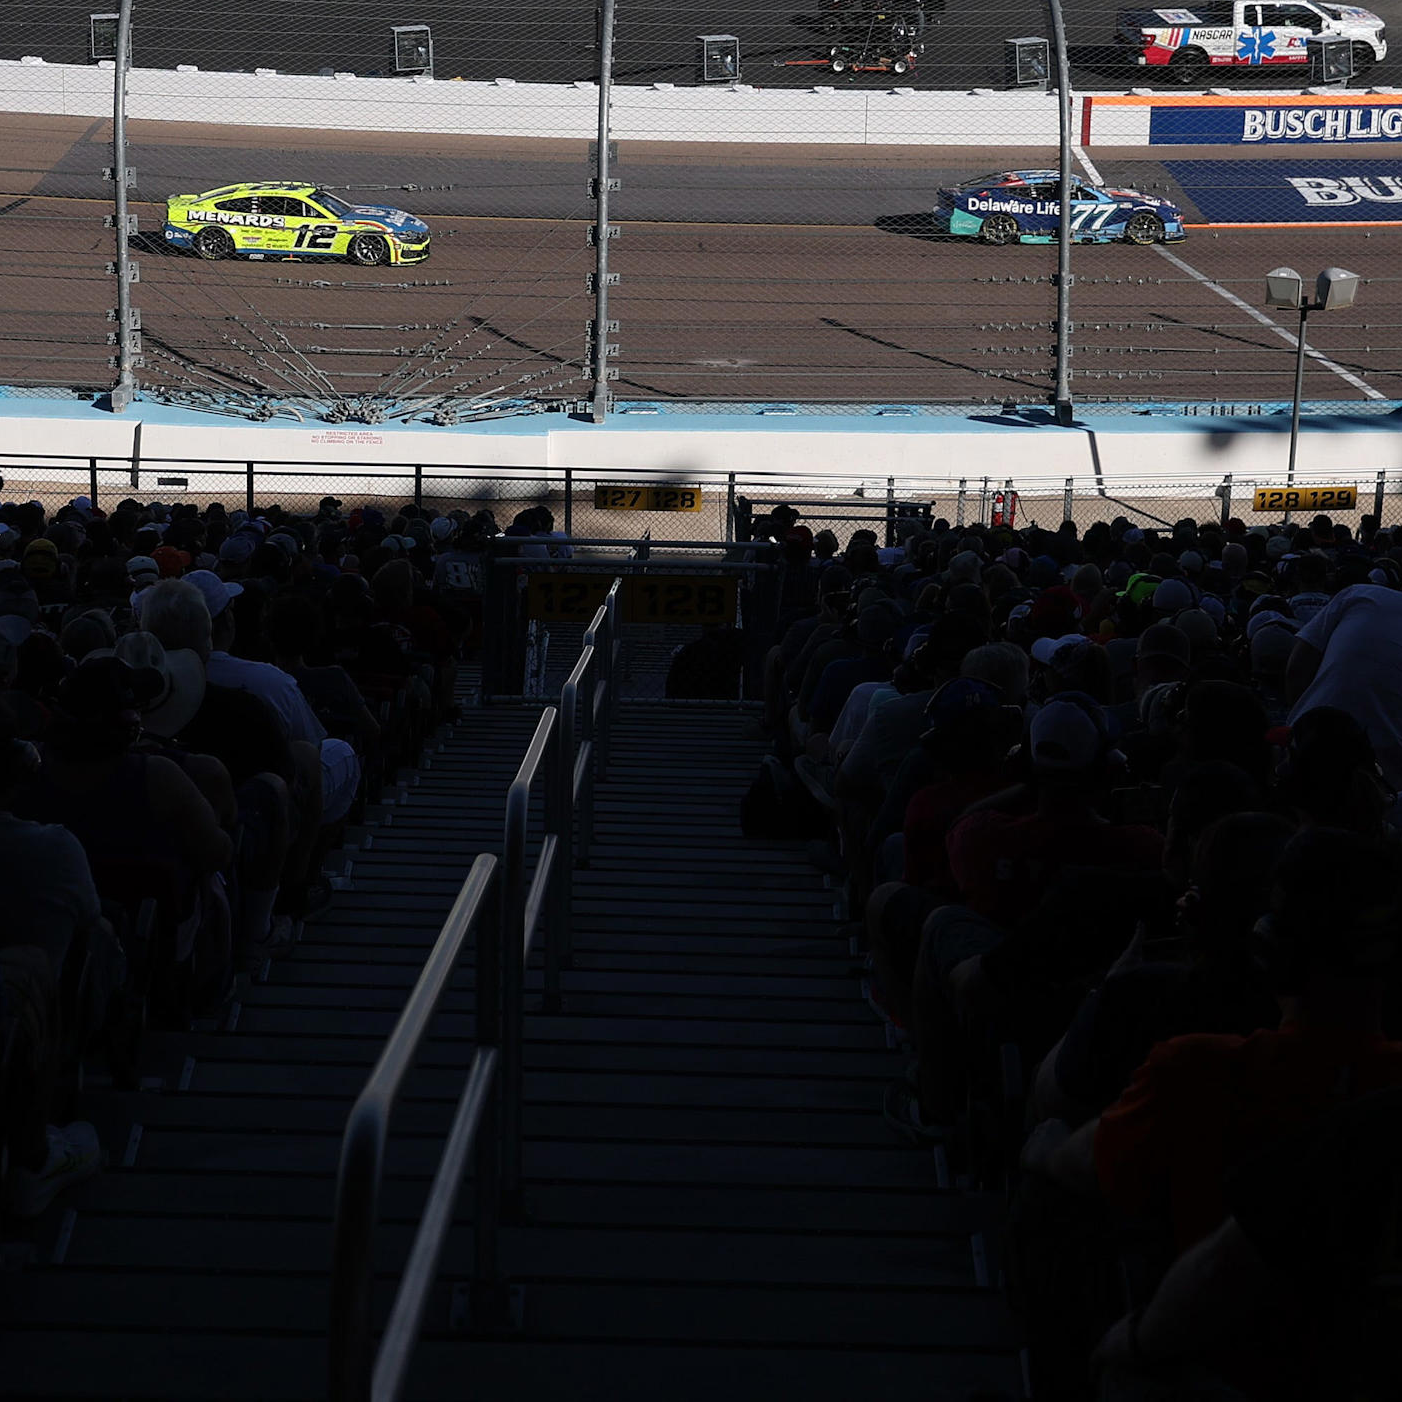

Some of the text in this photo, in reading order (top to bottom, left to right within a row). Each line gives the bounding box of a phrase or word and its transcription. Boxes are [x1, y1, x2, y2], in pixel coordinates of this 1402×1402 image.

[1192, 28, 1233, 41] NASCAR
[968, 197, 1061, 216] Delaware Life
[186, 209, 286, 228] MENARDS
[1071, 203, 1118, 231] 77
[294, 223, 339, 249] 12
[601, 489, 695, 509] 127 128
[1258, 490, 1352, 508] 128 129
[640, 584, 725, 616] 128
